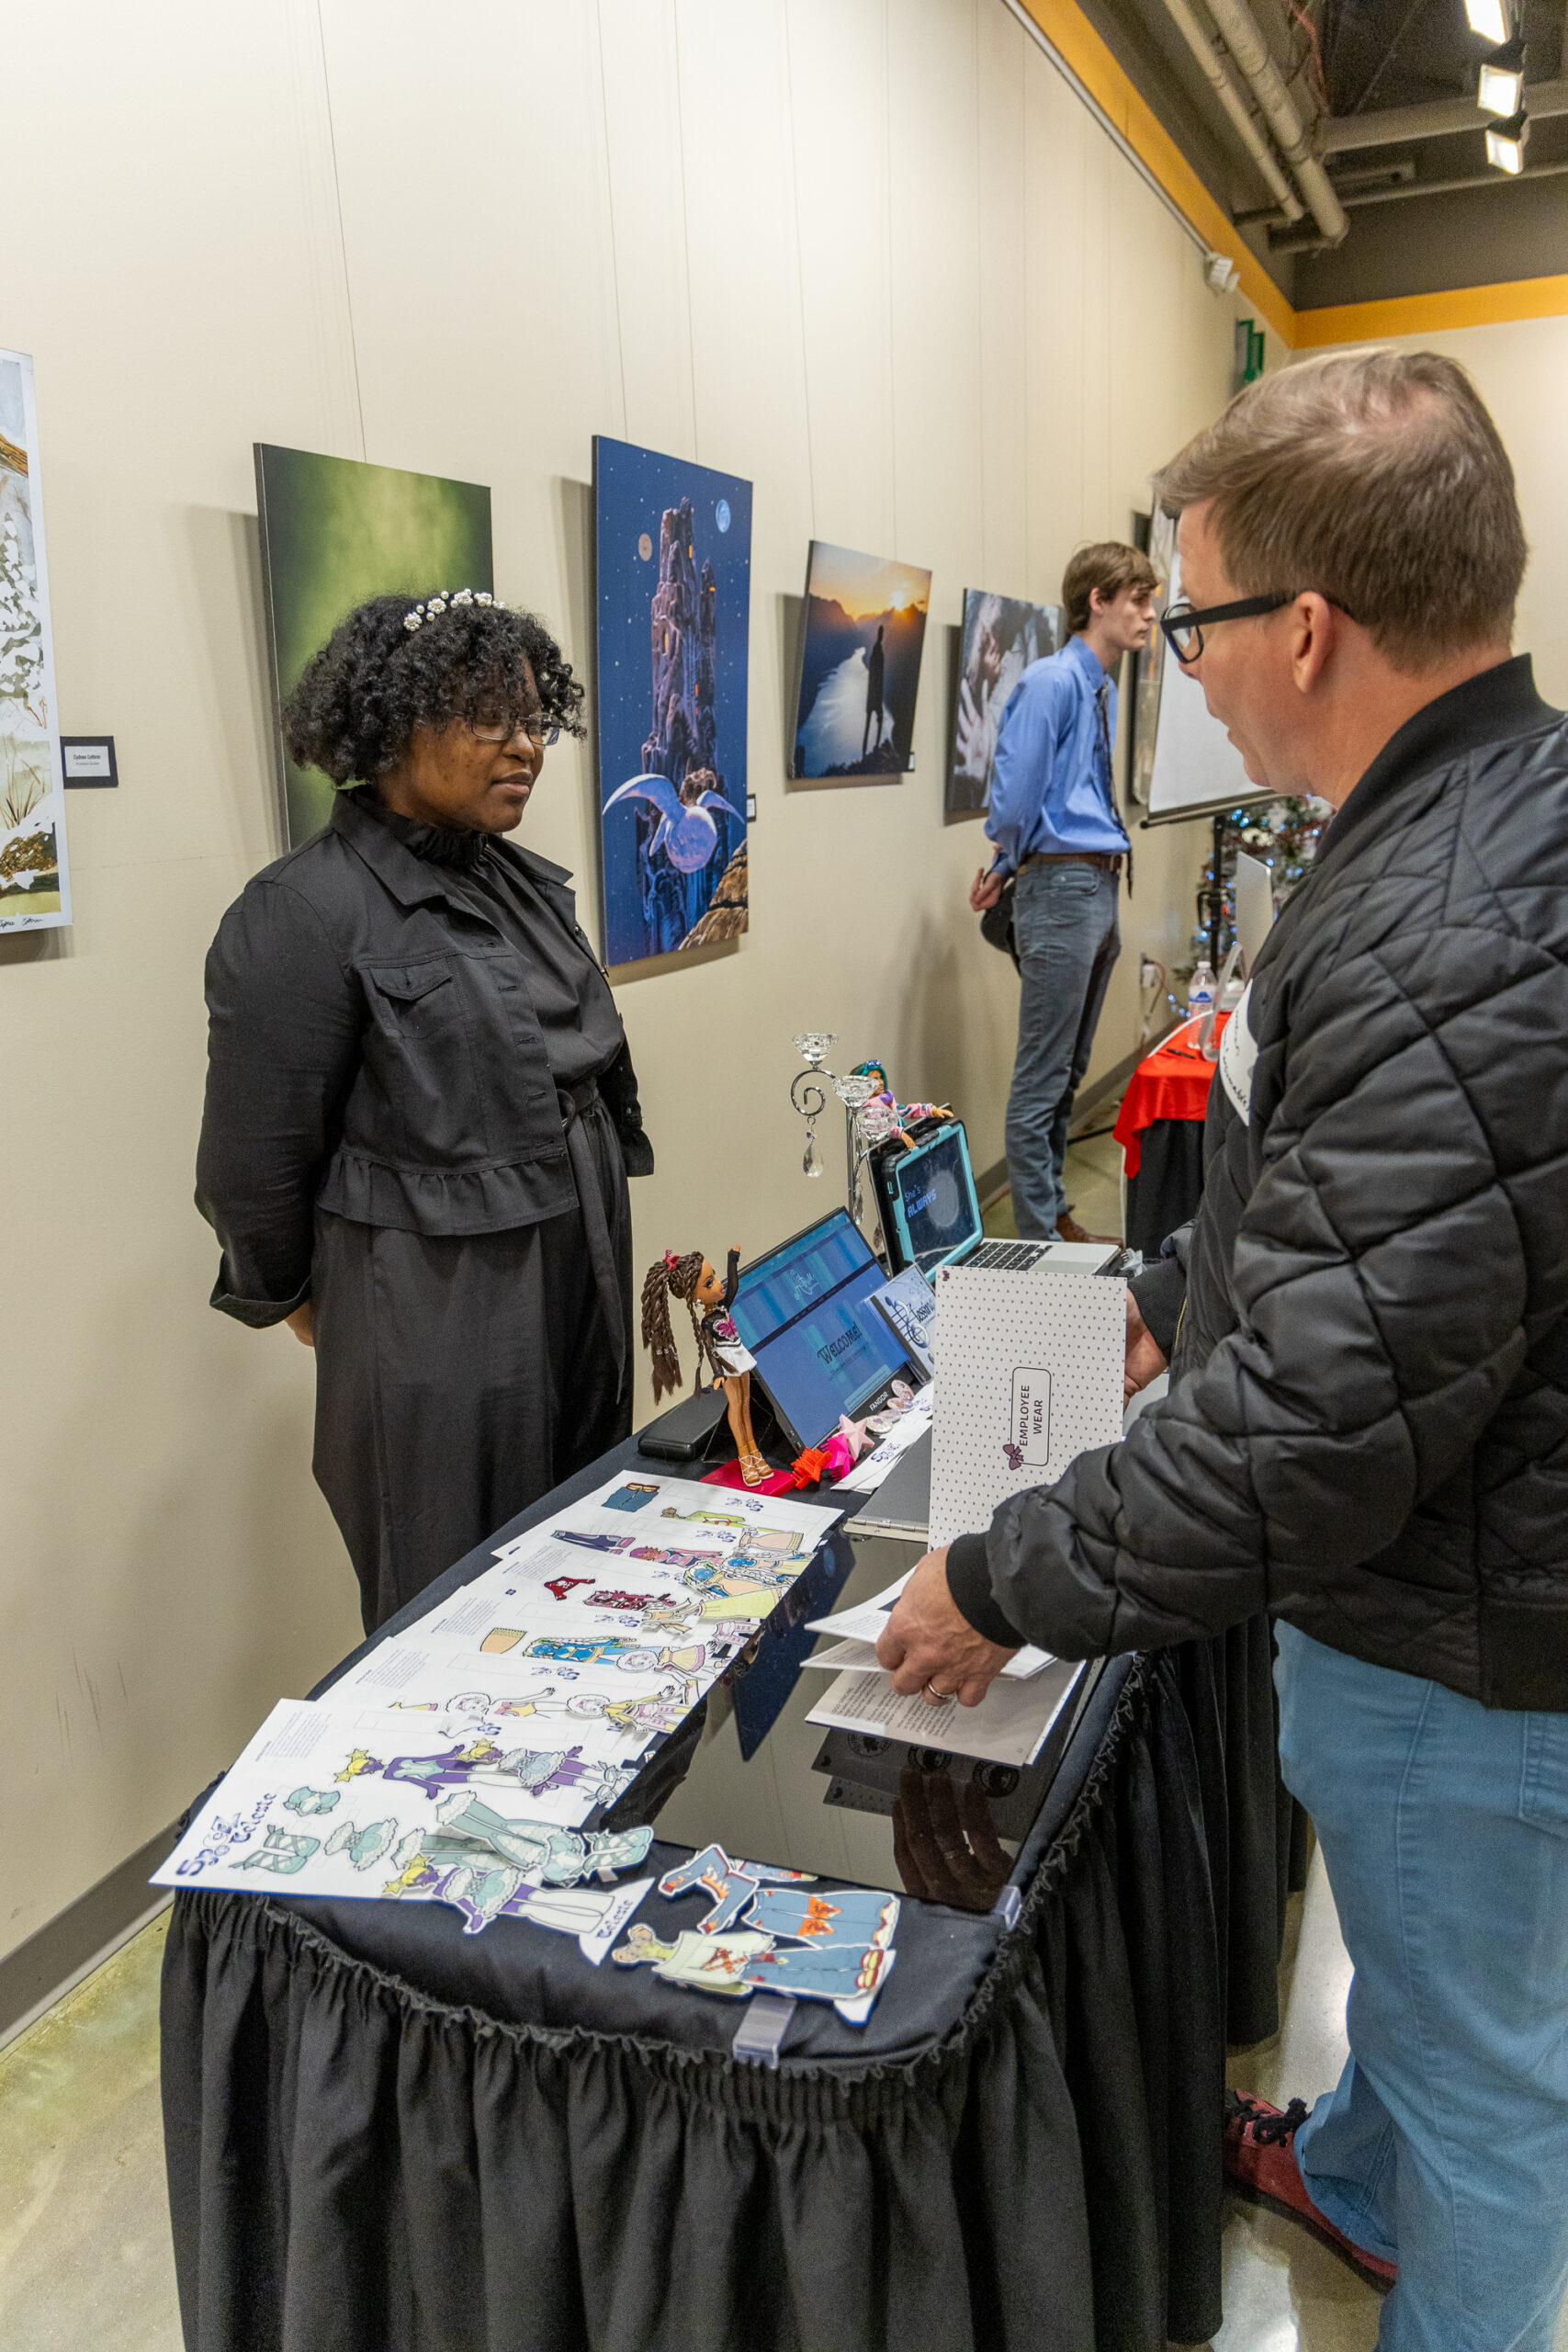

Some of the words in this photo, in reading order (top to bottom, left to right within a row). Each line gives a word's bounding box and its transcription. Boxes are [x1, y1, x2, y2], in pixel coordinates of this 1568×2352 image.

[904, 1184, 921, 1203] She's
[907, 1189, 937, 1218] ALWAYS
[869, 1391, 889, 1411] FANGOR
[1019, 1385, 1030, 1446] EMPLOYEE
[1032, 1399, 1043, 1435] WEAR
